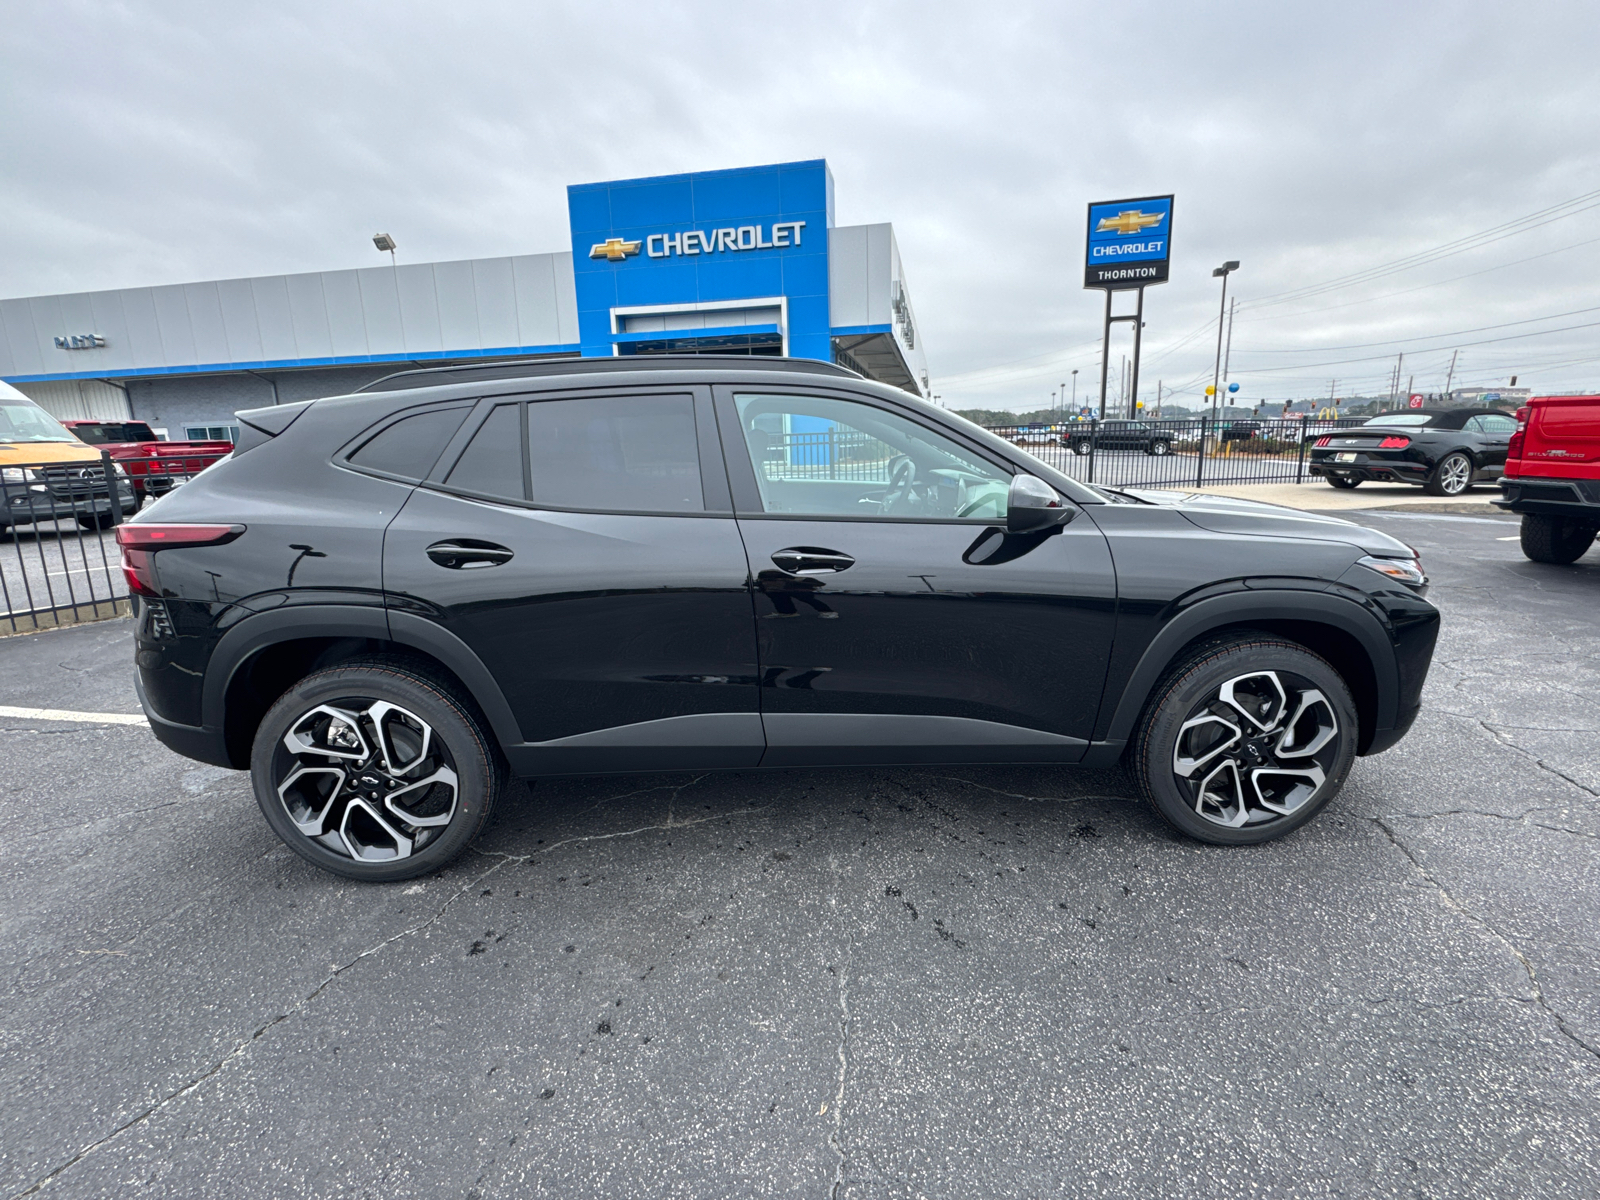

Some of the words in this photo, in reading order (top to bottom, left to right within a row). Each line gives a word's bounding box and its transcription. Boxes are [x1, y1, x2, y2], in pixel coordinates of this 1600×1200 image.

[646, 221, 807, 258] CHEVROLET
[1093, 242, 1163, 256] CHEVROLET
[1098, 267, 1156, 280] THORNTON
[54, 334, 98, 349] PARTS
